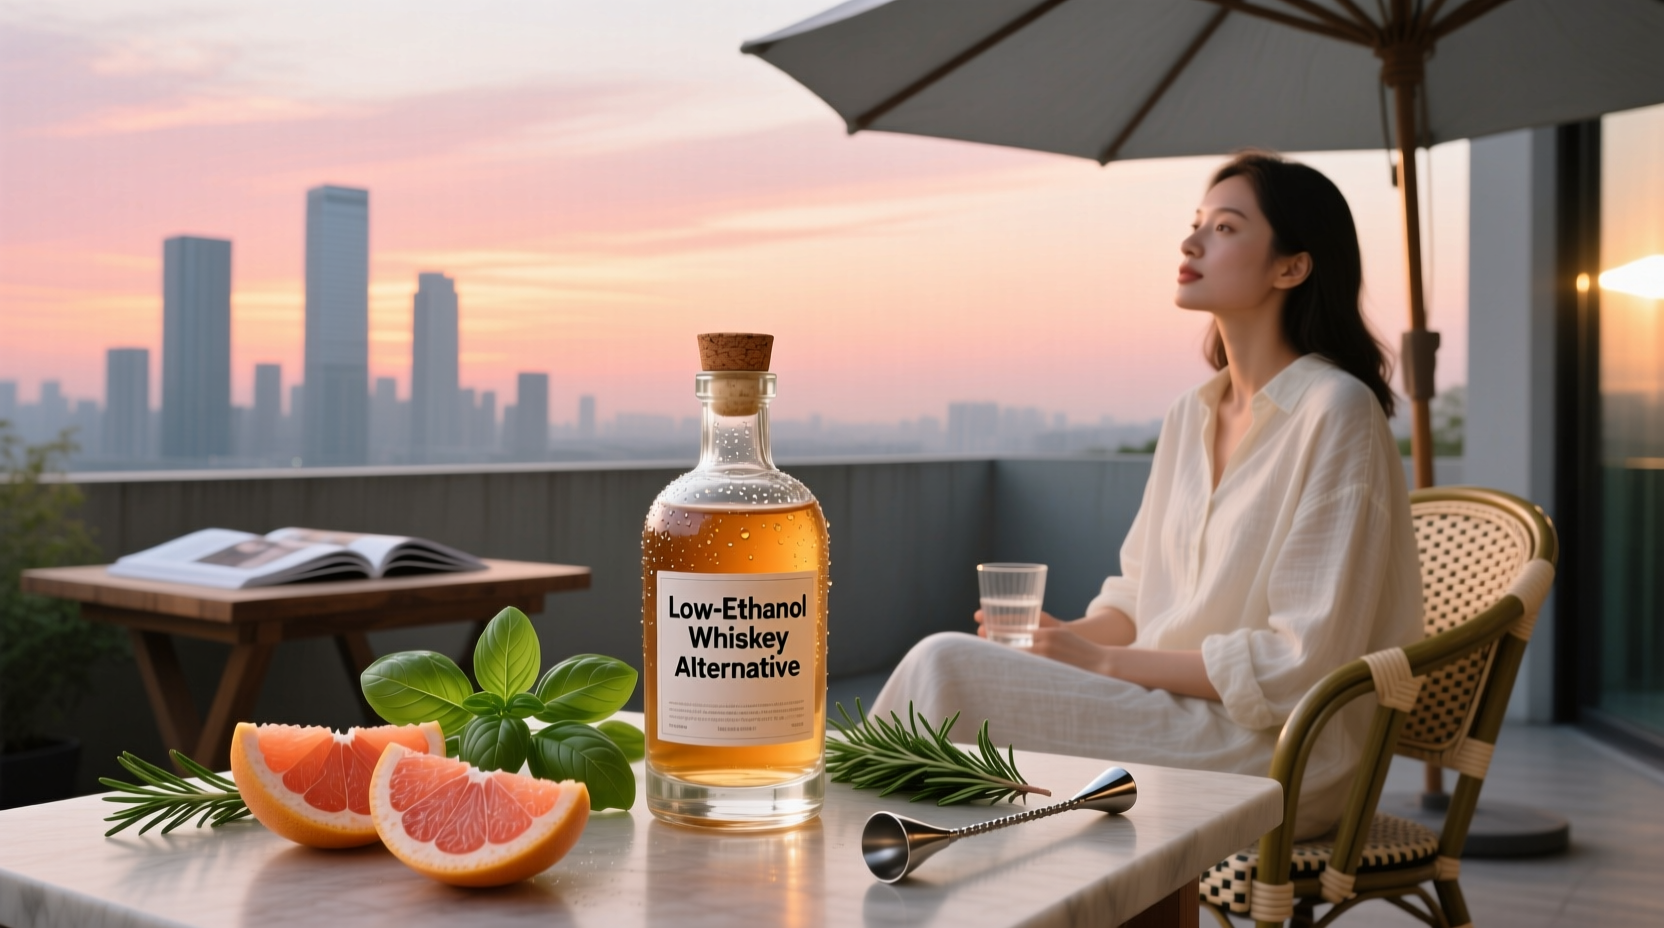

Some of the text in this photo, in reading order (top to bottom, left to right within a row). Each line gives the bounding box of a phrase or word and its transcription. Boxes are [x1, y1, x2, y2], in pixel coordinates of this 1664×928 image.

[669, 594, 807, 621] Low-Ethanol
[688, 625, 790, 655] Whiskey
[674, 654, 801, 679] Alternative
